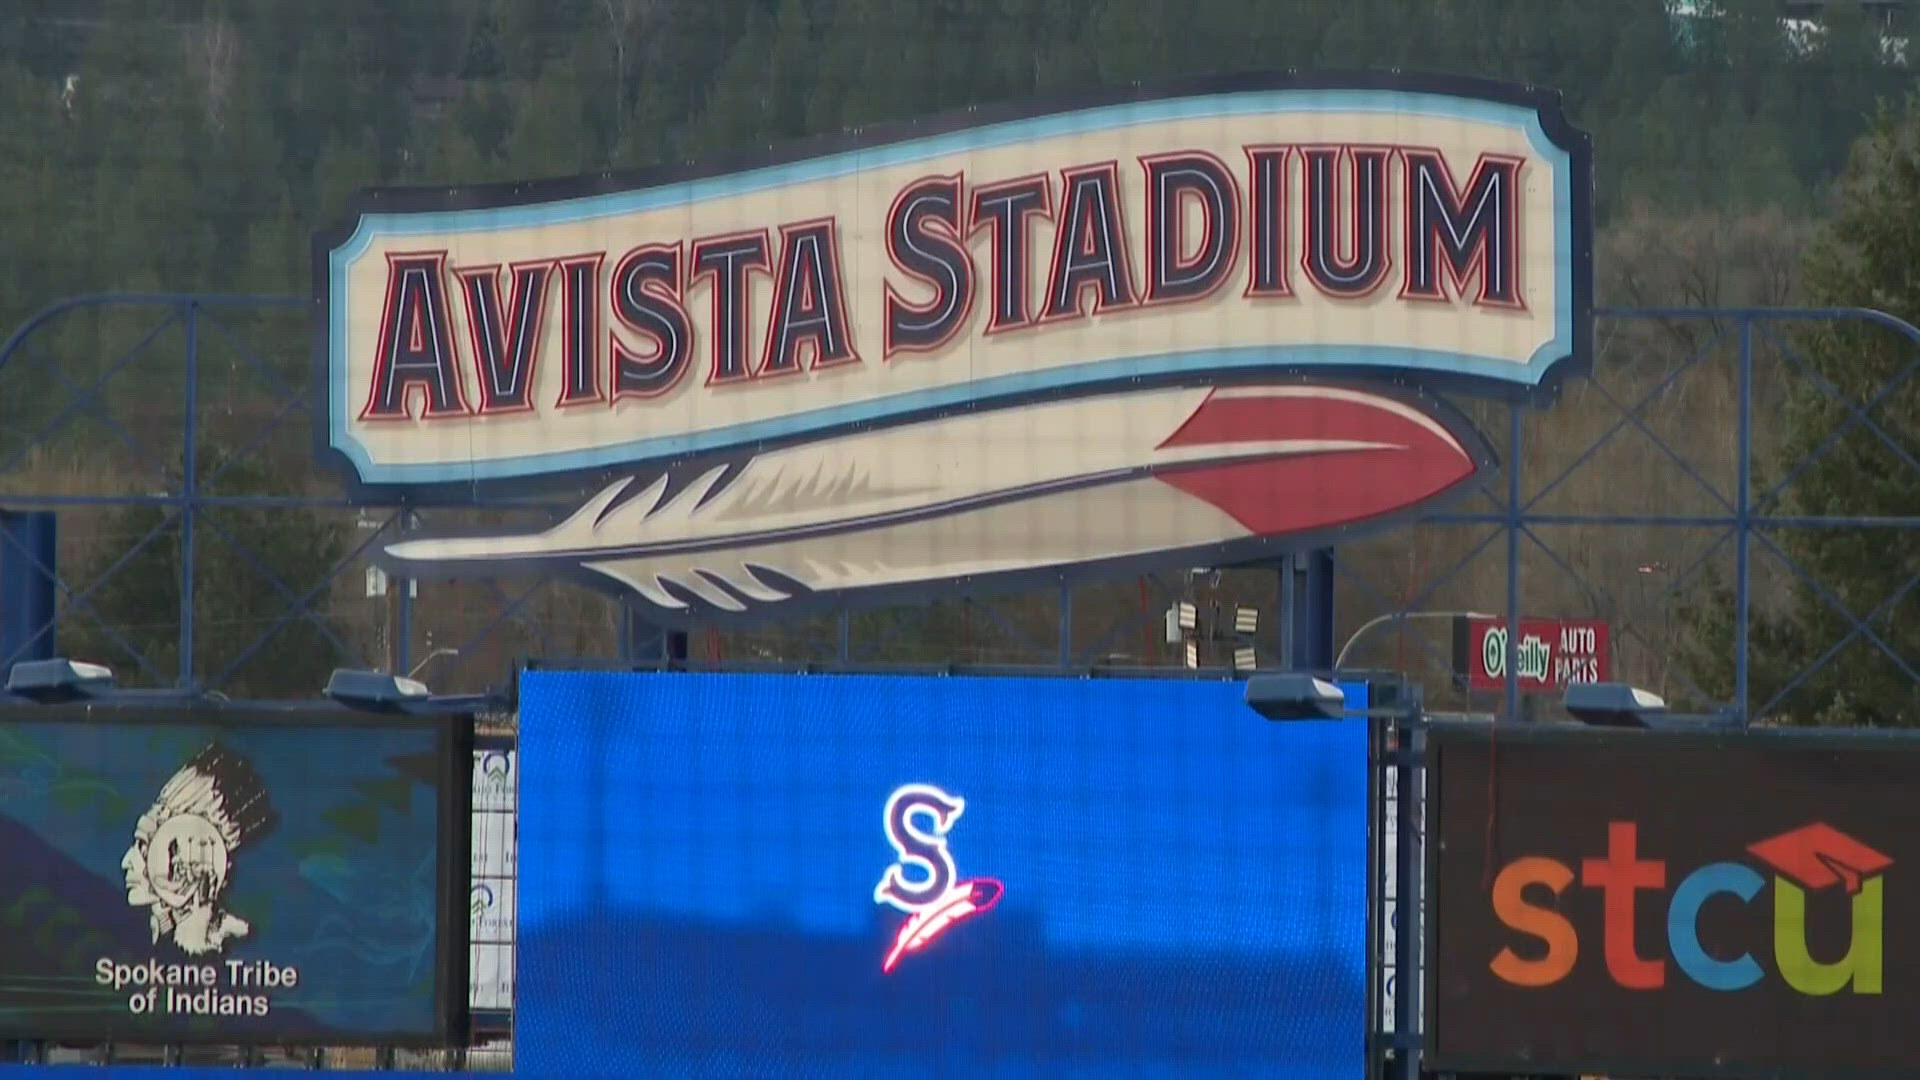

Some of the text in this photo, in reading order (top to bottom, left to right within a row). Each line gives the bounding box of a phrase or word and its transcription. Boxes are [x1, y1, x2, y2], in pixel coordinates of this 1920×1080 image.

[358, 144, 1528, 422] AVISTA STADIUM
[1560, 627, 1595, 654] AUTO
[1555, 657, 1598, 684] PARTS
[1489, 821, 1885, 996] stcu
[95, 957, 298, 991] Spokane Tribe
[129, 987, 269, 1016] of Indians
